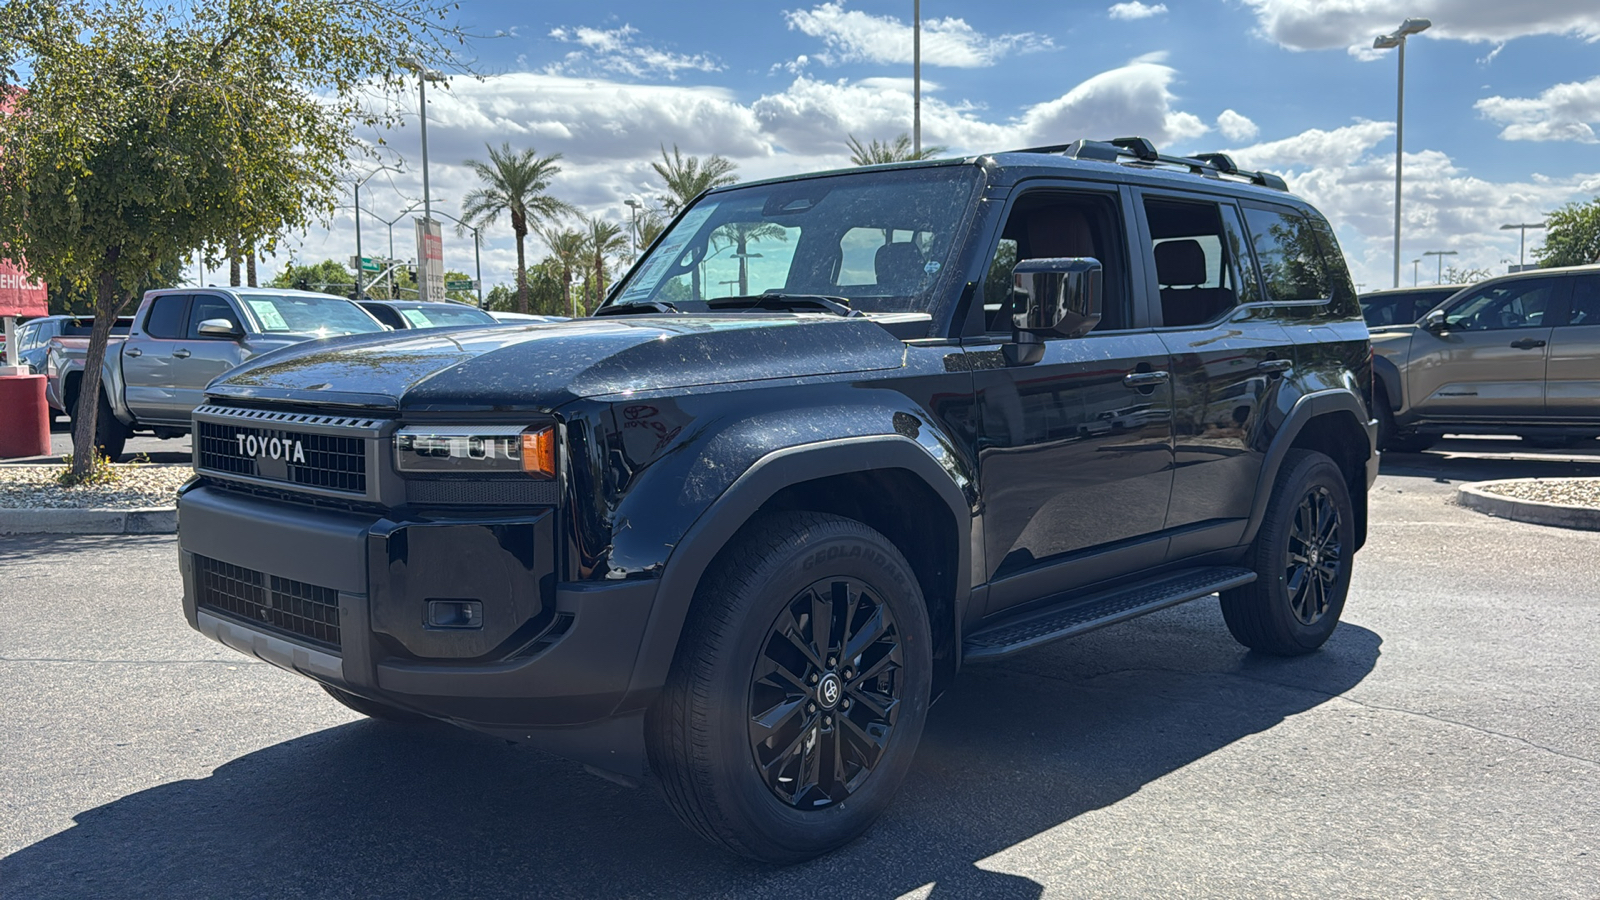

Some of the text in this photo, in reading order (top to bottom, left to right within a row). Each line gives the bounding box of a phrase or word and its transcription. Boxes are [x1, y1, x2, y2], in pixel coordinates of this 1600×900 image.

[0, 274, 43, 290] EHICLS
[236, 433, 305, 463] TOYOTA
[802, 545, 905, 584] GEOLANDAR
